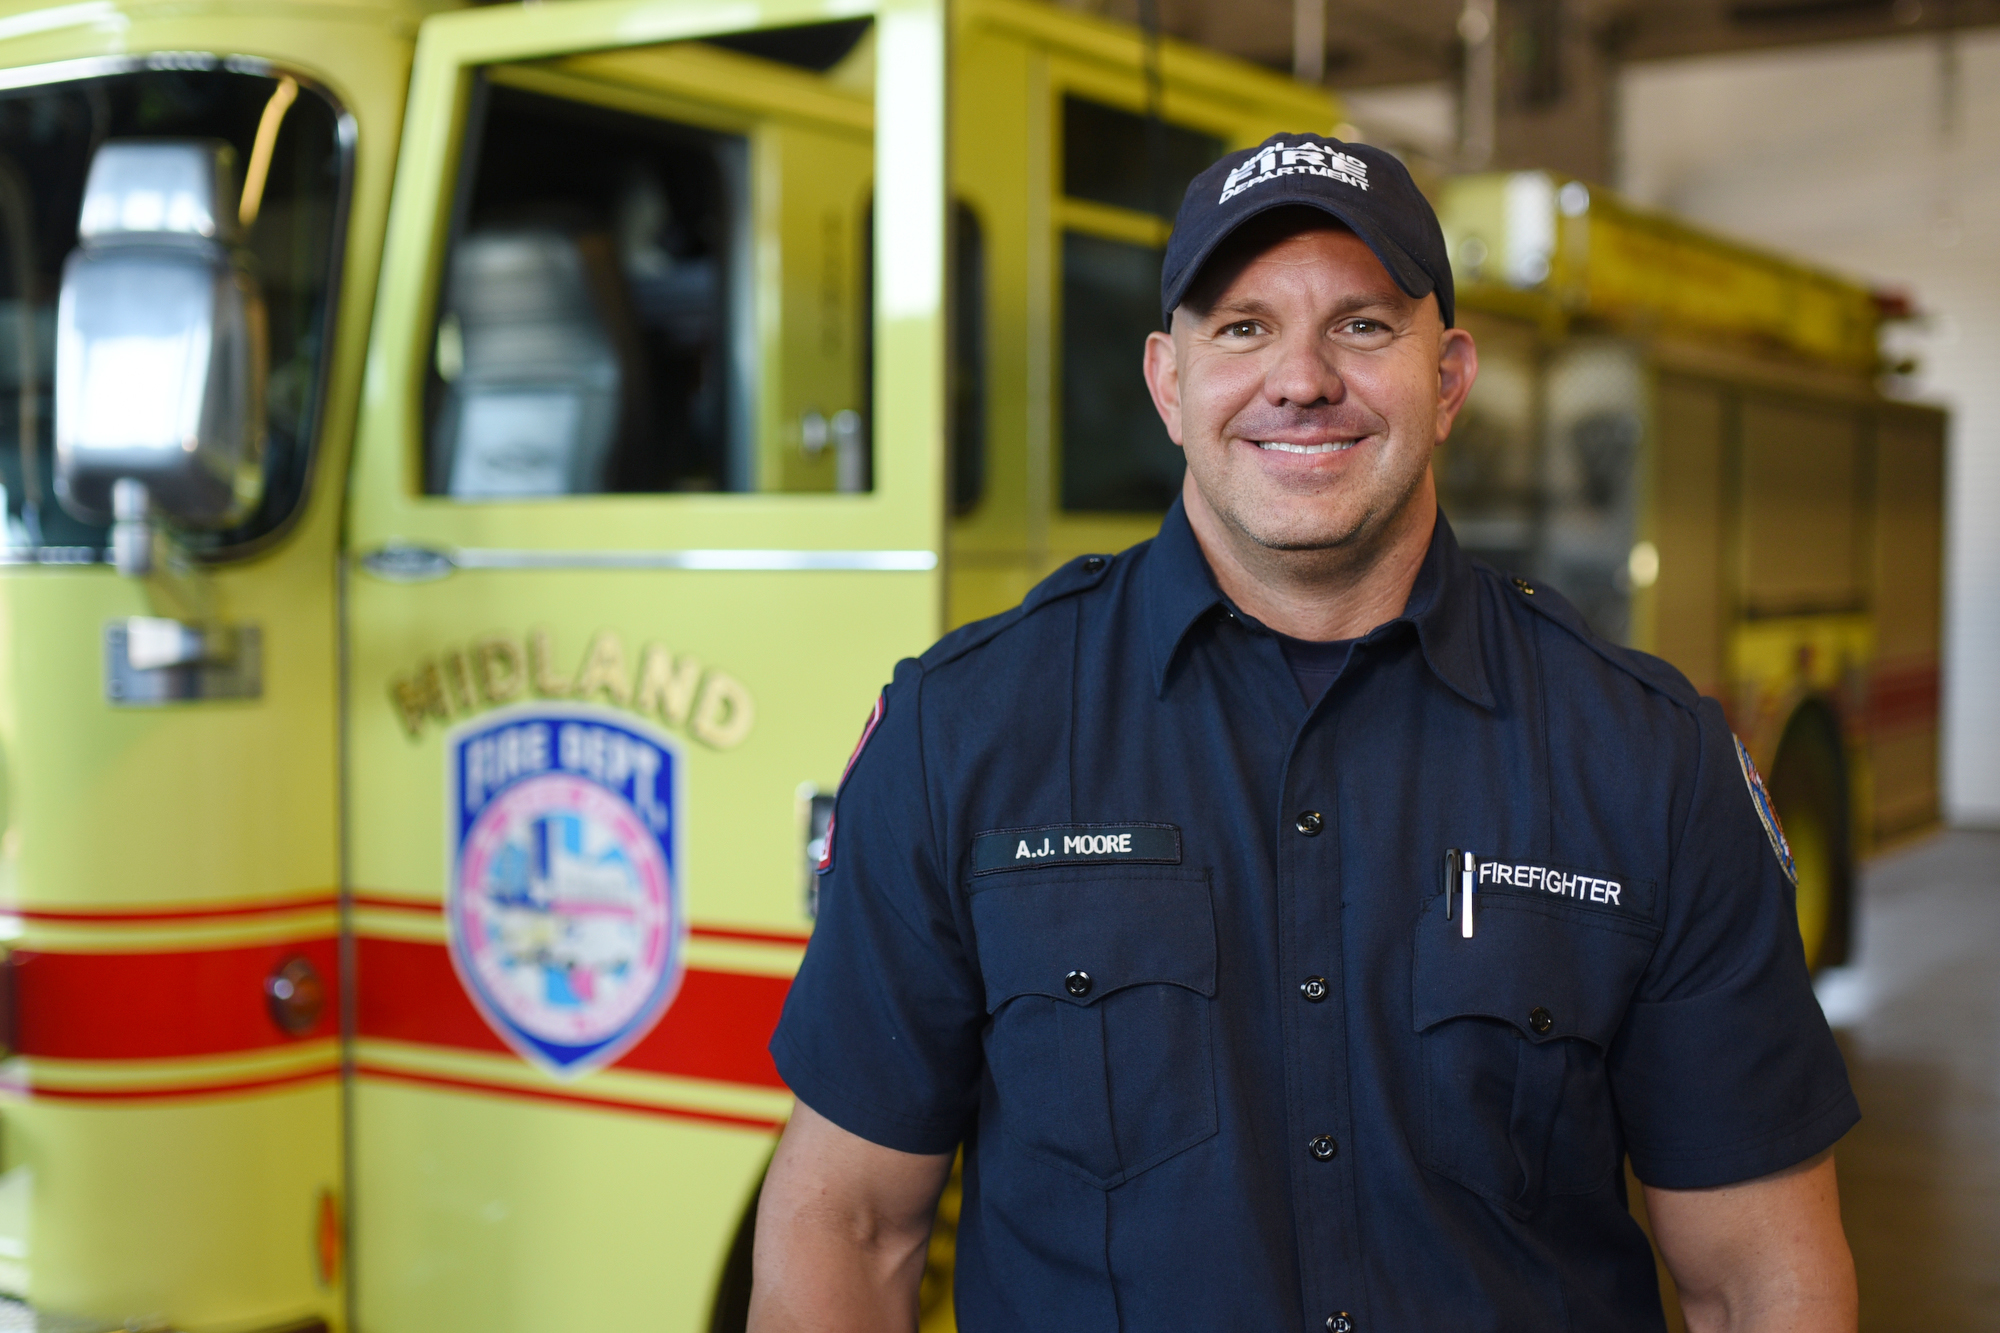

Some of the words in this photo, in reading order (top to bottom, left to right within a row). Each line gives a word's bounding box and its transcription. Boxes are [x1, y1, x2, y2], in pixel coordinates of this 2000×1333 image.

[1218, 166, 1370, 205] DEPARTMENT
[1222, 150, 1369, 192] FIRE
[390, 628, 754, 750] MIDLAND
[464, 722, 548, 813] FIRE
[1015, 838, 1055, 859] A.J.
[1063, 833, 1132, 855] MOORE
[1479, 861, 1622, 906] FIREFIGHTER
